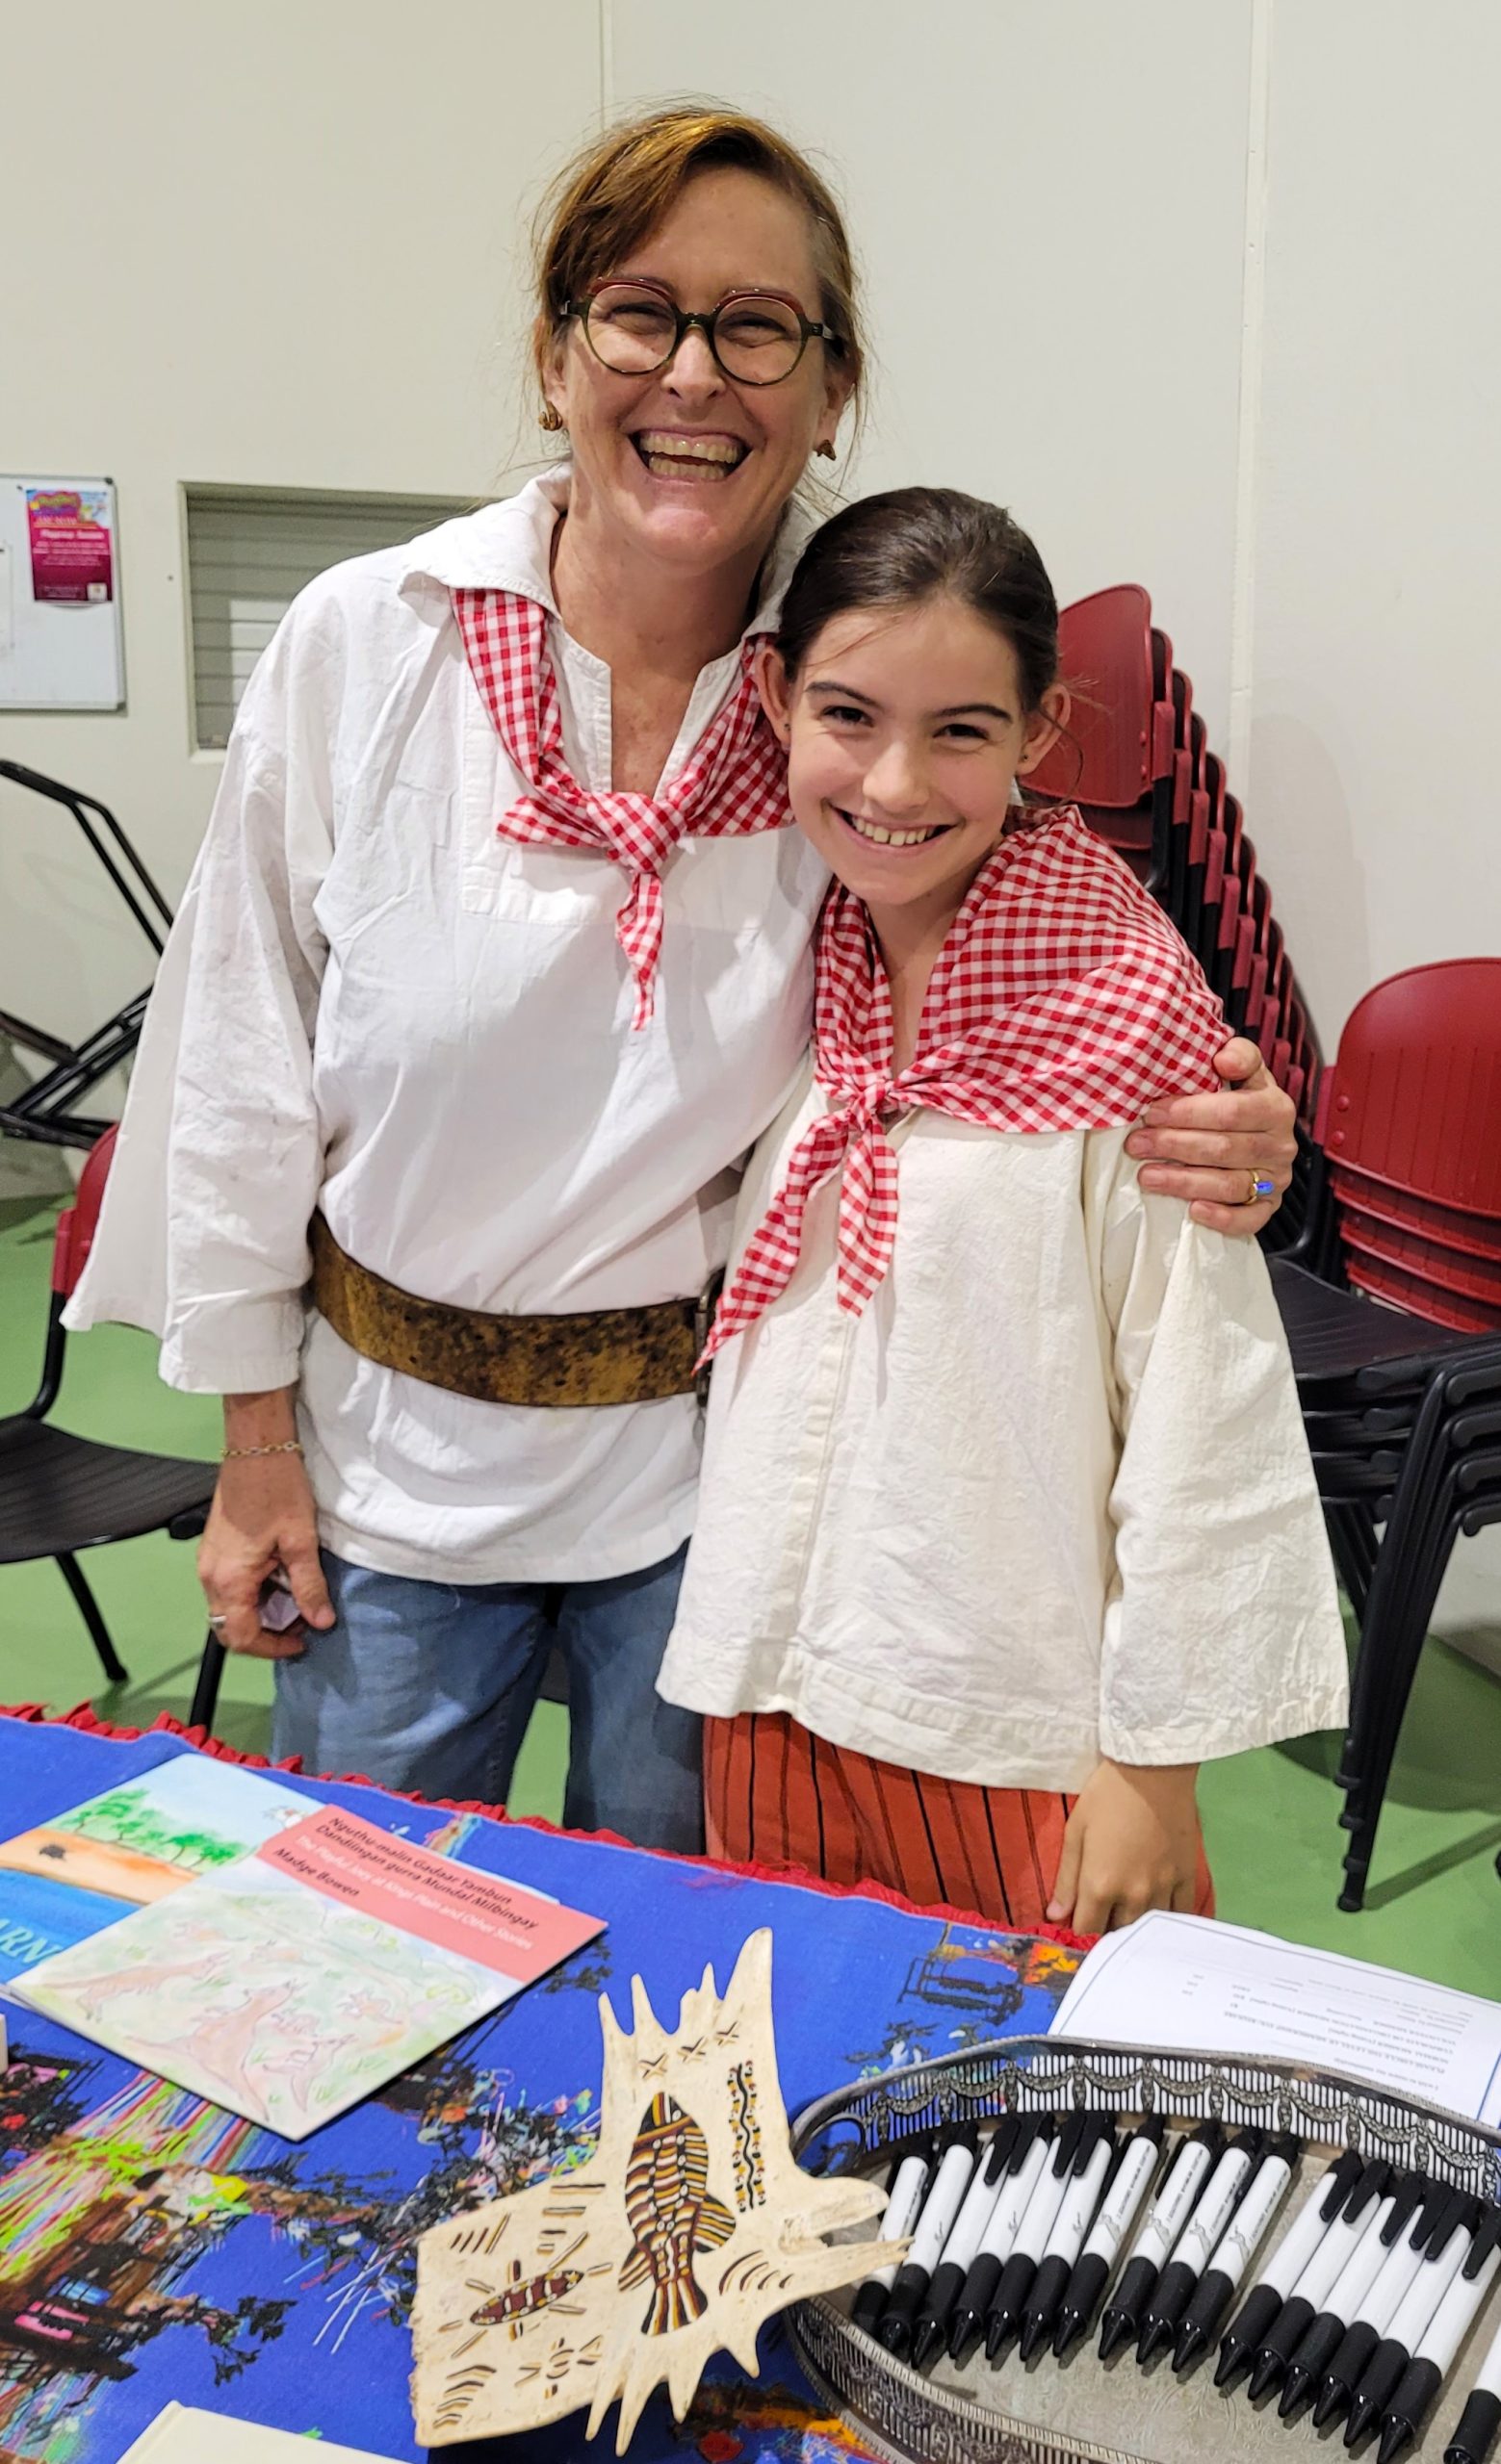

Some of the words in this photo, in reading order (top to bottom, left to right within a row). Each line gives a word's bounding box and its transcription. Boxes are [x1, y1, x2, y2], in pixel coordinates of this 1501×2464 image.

[272, 1848, 318, 1876] Madge
[316, 1871, 361, 1897] Bowen
[421, 1876, 475, 1901] Mundal
[460, 1878, 512, 1904] Yambun
[0, 1918, 63, 1964] RN
